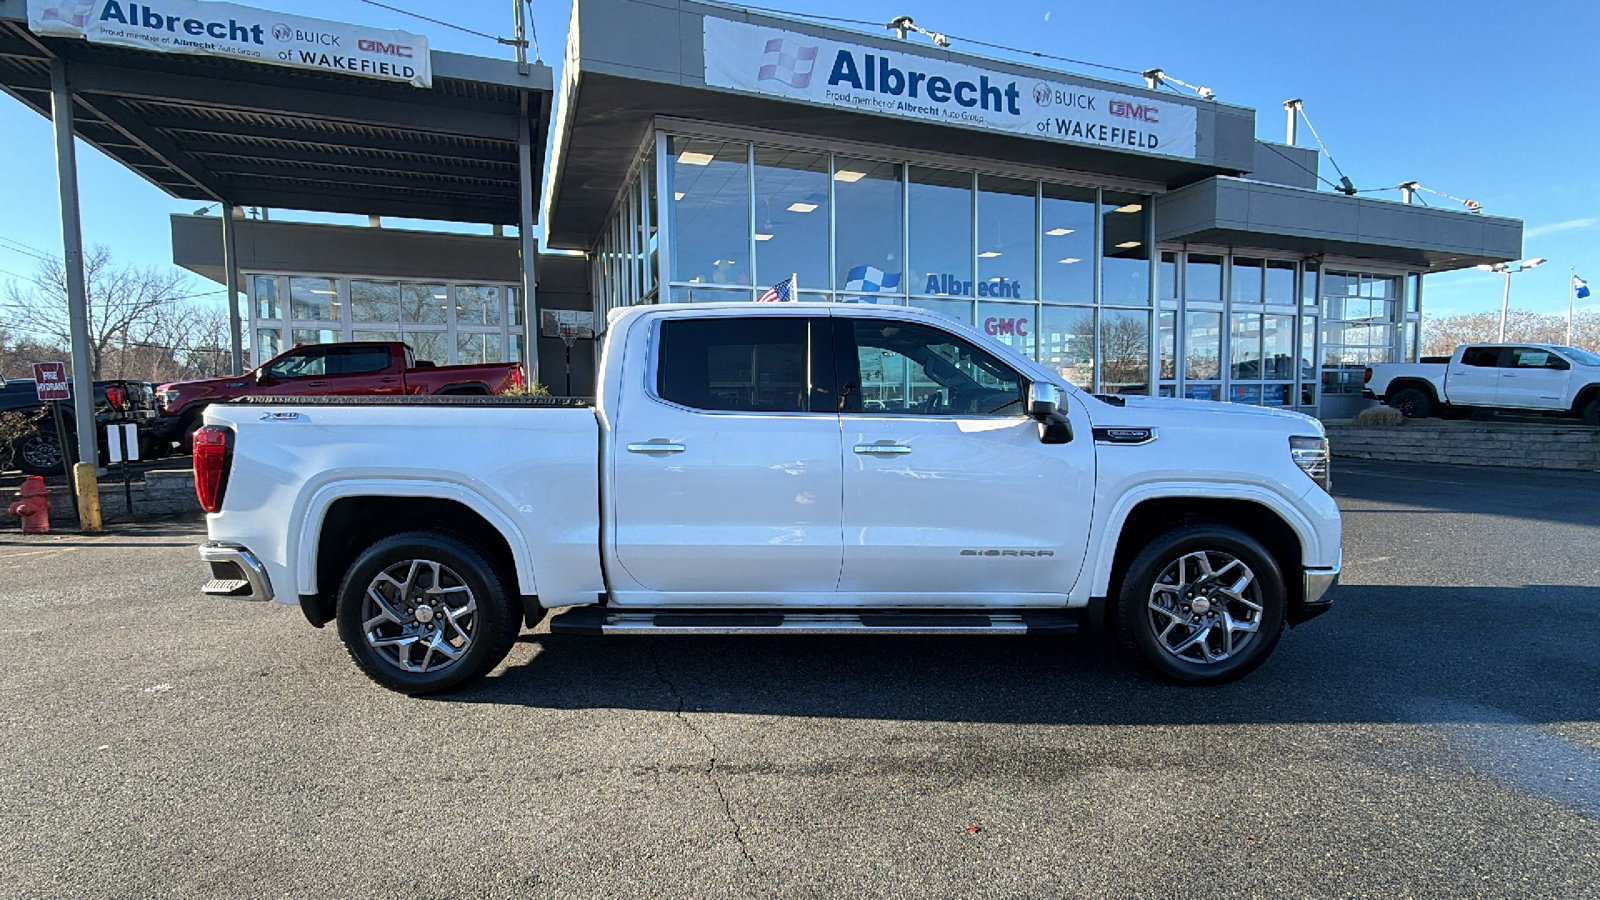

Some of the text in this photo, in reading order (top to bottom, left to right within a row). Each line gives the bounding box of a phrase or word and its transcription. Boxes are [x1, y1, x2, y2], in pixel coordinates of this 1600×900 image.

[100, 0, 264, 45] Albrecht
[100, 27, 261, 57] Proud member of Albrecht Auto Group
[296, 29, 341, 47] BUICK
[357, 39, 413, 58] GMC
[278, 49, 415, 78] of WAKEFIELD
[827, 49, 1021, 115] Albrecht
[826, 89, 984, 123] Proud member of Albrecht Auto Group
[1055, 90, 1096, 111] BUICK
[1109, 99, 1159, 123] GMC
[1036, 118, 1159, 149] of WAKEFIELD
[925, 273, 1020, 298] Albrecht
[984, 317, 1028, 336] GMC
[37, 382, 68, 391] HYDRANT
[960, 549, 1054, 557] SIERRA
